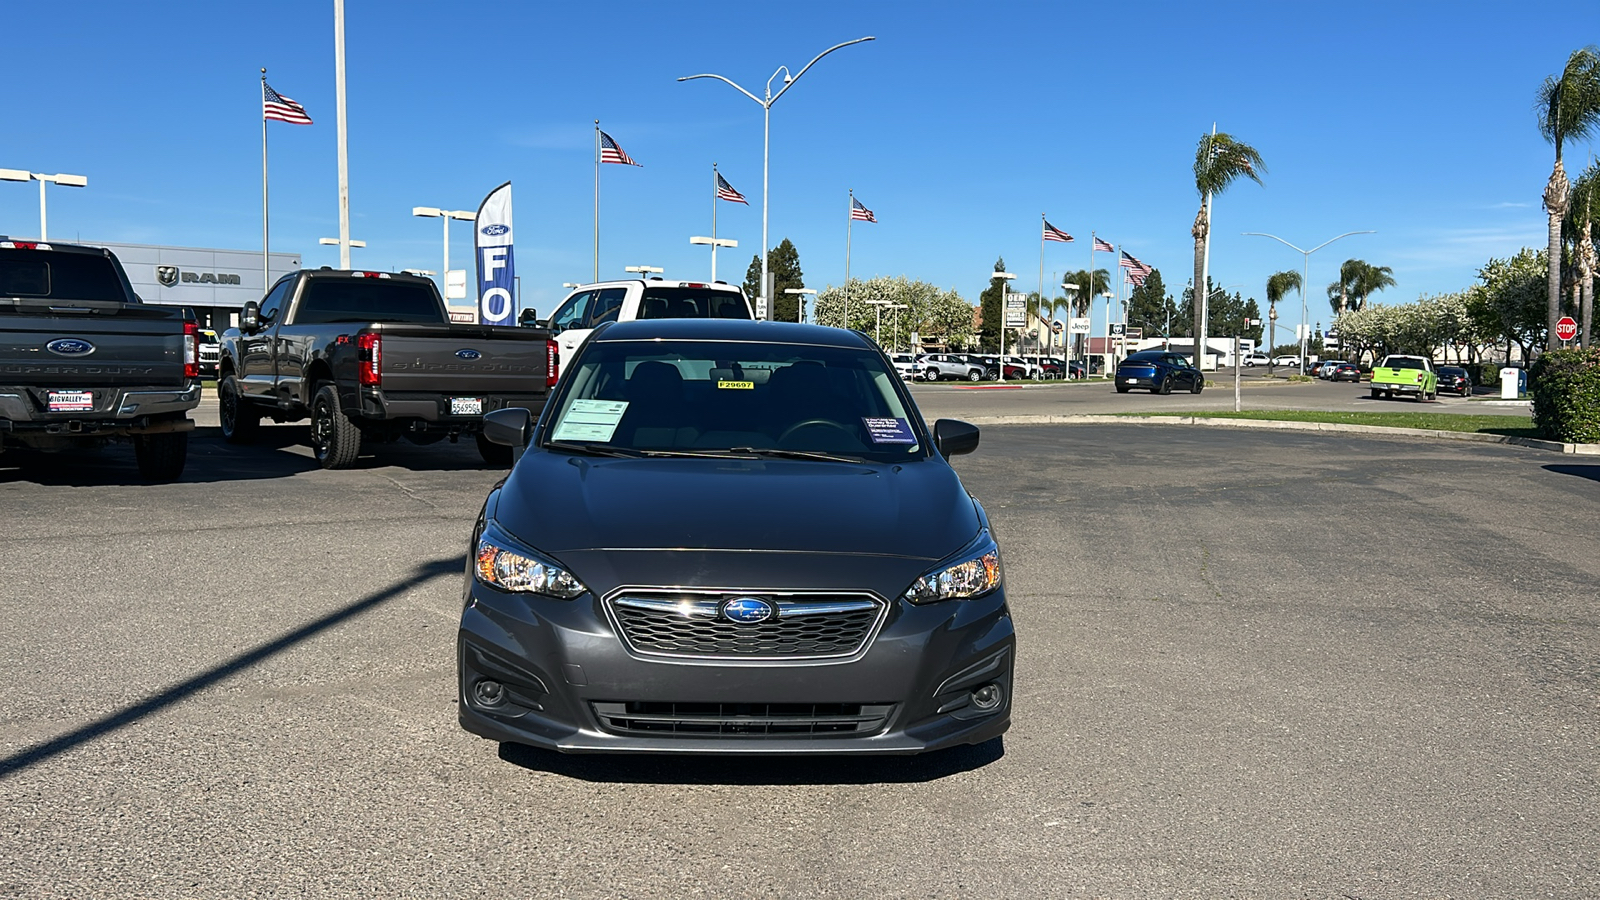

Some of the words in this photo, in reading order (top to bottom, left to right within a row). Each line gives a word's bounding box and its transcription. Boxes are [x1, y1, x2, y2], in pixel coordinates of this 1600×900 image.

[181, 272, 240, 285] RAM
[1557, 324, 1575, 333] STOP
[58, 342, 83, 352] Ford
[391, 363, 476, 371] SUPER
[482, 363, 539, 371] DUTY
